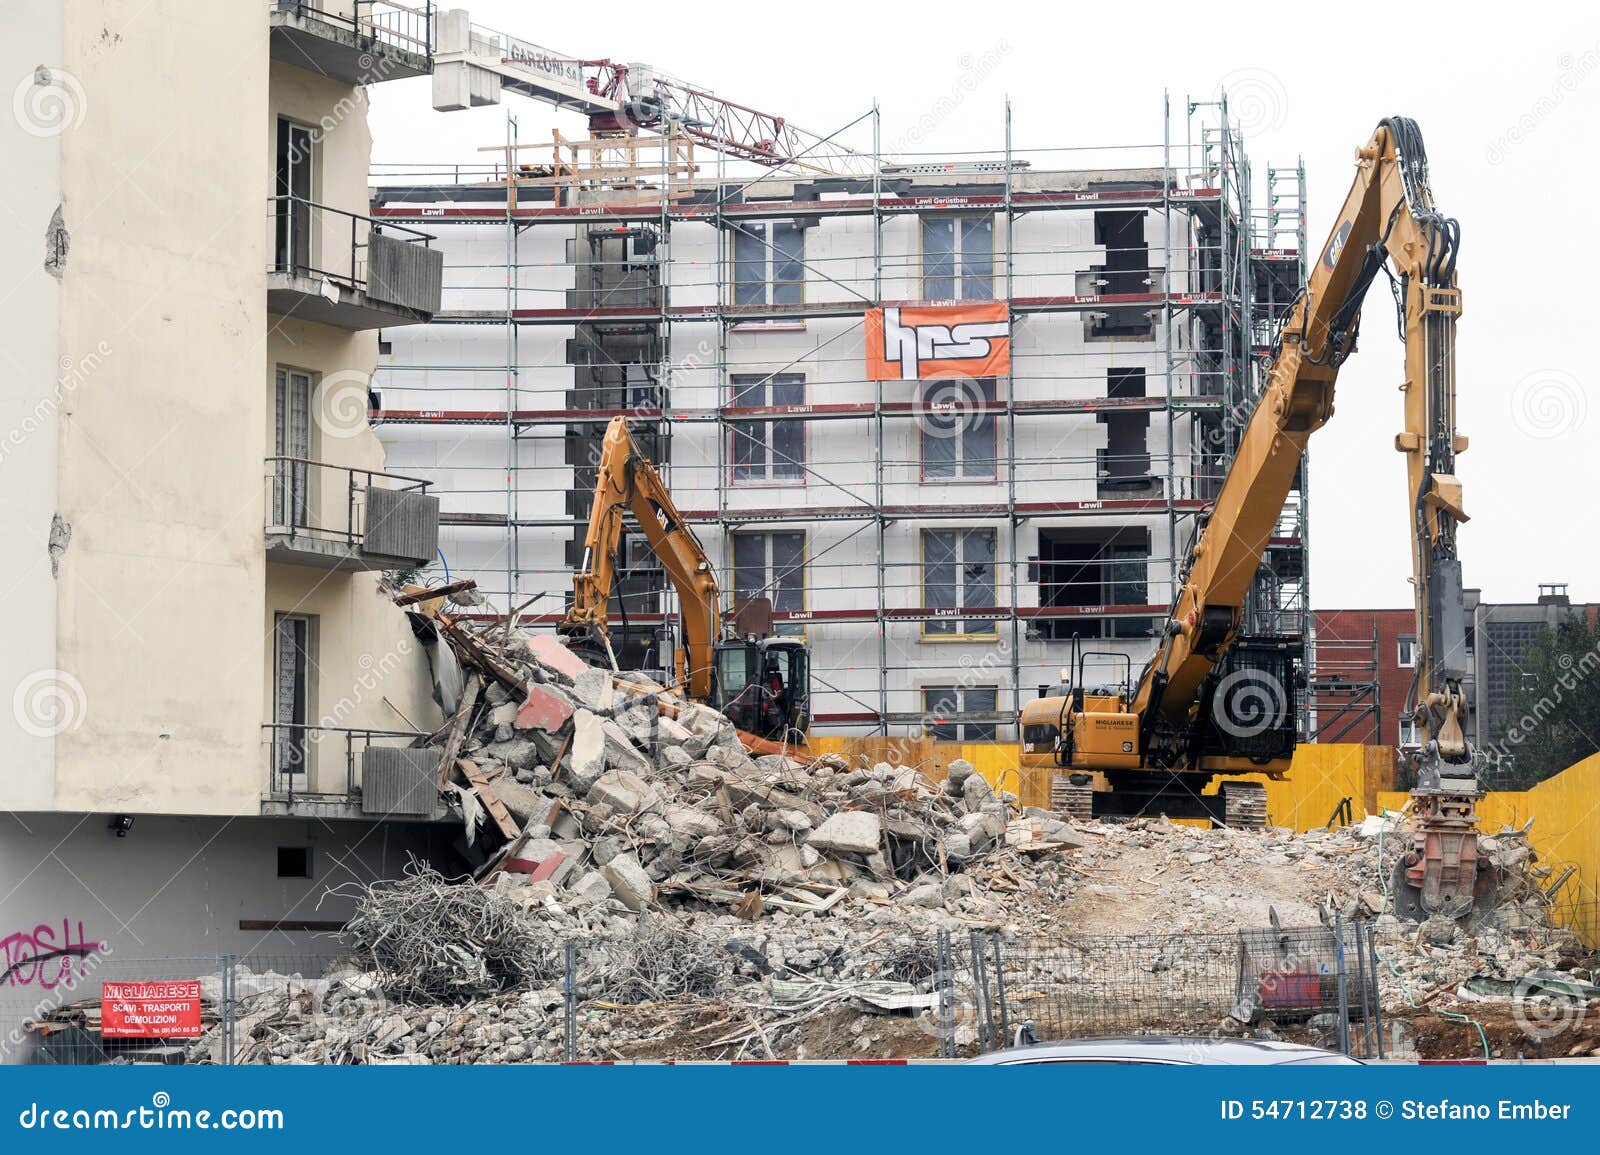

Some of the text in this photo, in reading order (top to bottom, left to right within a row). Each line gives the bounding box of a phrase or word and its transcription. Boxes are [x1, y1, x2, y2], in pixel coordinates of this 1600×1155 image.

[511, 44, 577, 80] GARZONI SA
[1170, 189, 1195, 197] Lawil
[422, 208, 444, 216] Lawil
[580, 207, 604, 215] Lawil
[1330, 232, 1343, 265] CAT
[1075, 295, 1099, 303] Lawil
[1182, 292, 1206, 300] Lawil
[931, 299, 956, 307] Lawil
[788, 405, 812, 413] Lawil
[1079, 502, 1102, 510] Lawil
[657, 508, 668, 530] CAT
[935, 608, 960, 616] Lawil
[1080, 606, 1104, 614] Lawil
[789, 611, 812, 619] Lawil
[104, 984, 199, 998] MIGLIARESE
[113, 1004, 136, 1012] SCAVI
[142, 1003, 190, 1012] TRASPORTI
[124, 1015, 177, 1024] DEMOLIZIONI
